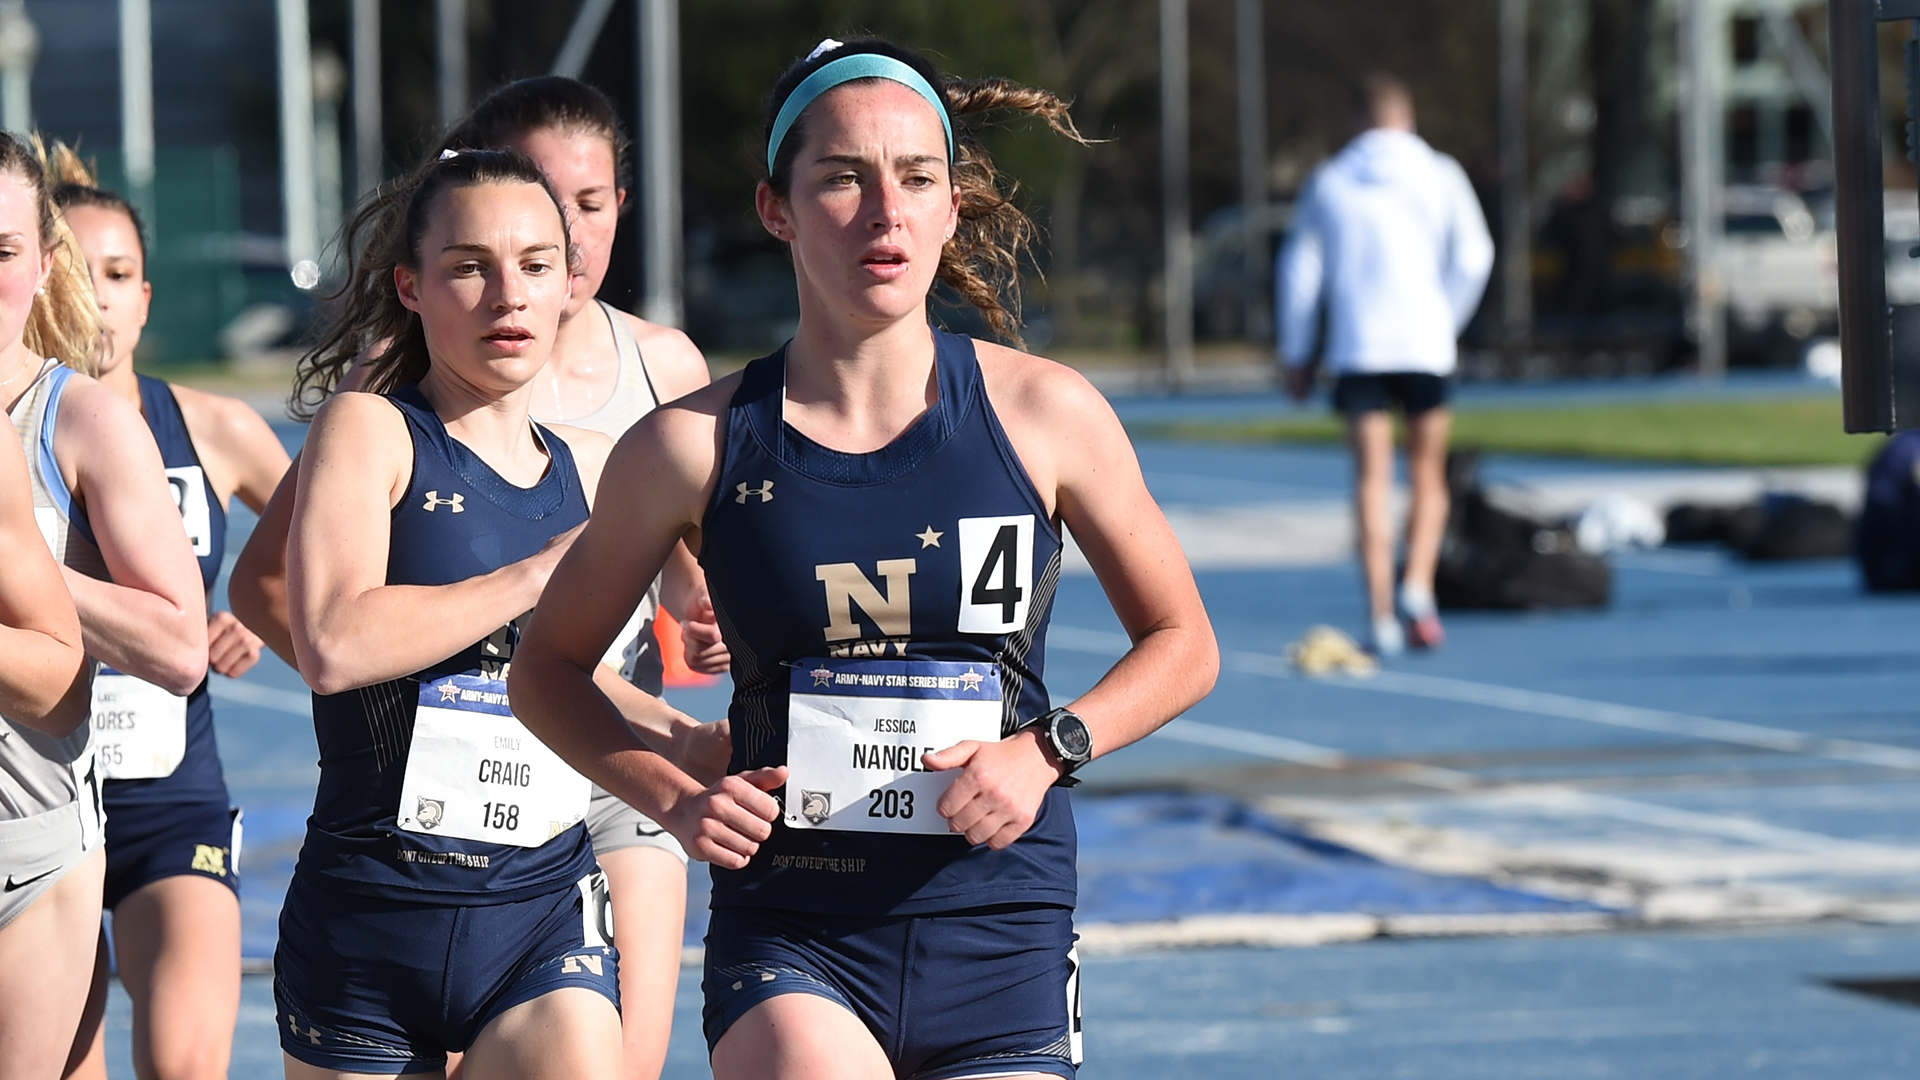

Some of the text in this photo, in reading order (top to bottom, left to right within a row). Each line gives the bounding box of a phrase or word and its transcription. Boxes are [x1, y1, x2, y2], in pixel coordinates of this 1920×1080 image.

[971, 524, 1023, 625] 4
[815, 558, 917, 642] N
[827, 638, 911, 658] NAVY
[835, 672, 885, 687] ARMY-NAVY
[886, 675, 908, 688] STAR
[908, 677, 938, 689] SERIES
[938, 678, 960, 689] MEET
[460, 689, 502, 705] ARMY-NAVY
[96, 711, 136, 731] ORES
[874, 718, 916, 734] JESSICA
[494, 736, 521, 750] EMILY
[98, 744, 123, 766] 65
[478, 759, 531, 788] CRAIG
[868, 788, 915, 819] 203
[483, 801, 520, 832] 158
[418, 850, 438, 864] GIVE
[448, 852, 467, 867] THE
[466, 854, 490, 869] SHIP
[795, 855, 815, 870] GIVE
[823, 857, 840, 873] THE
[840, 858, 866, 873] SHIP
